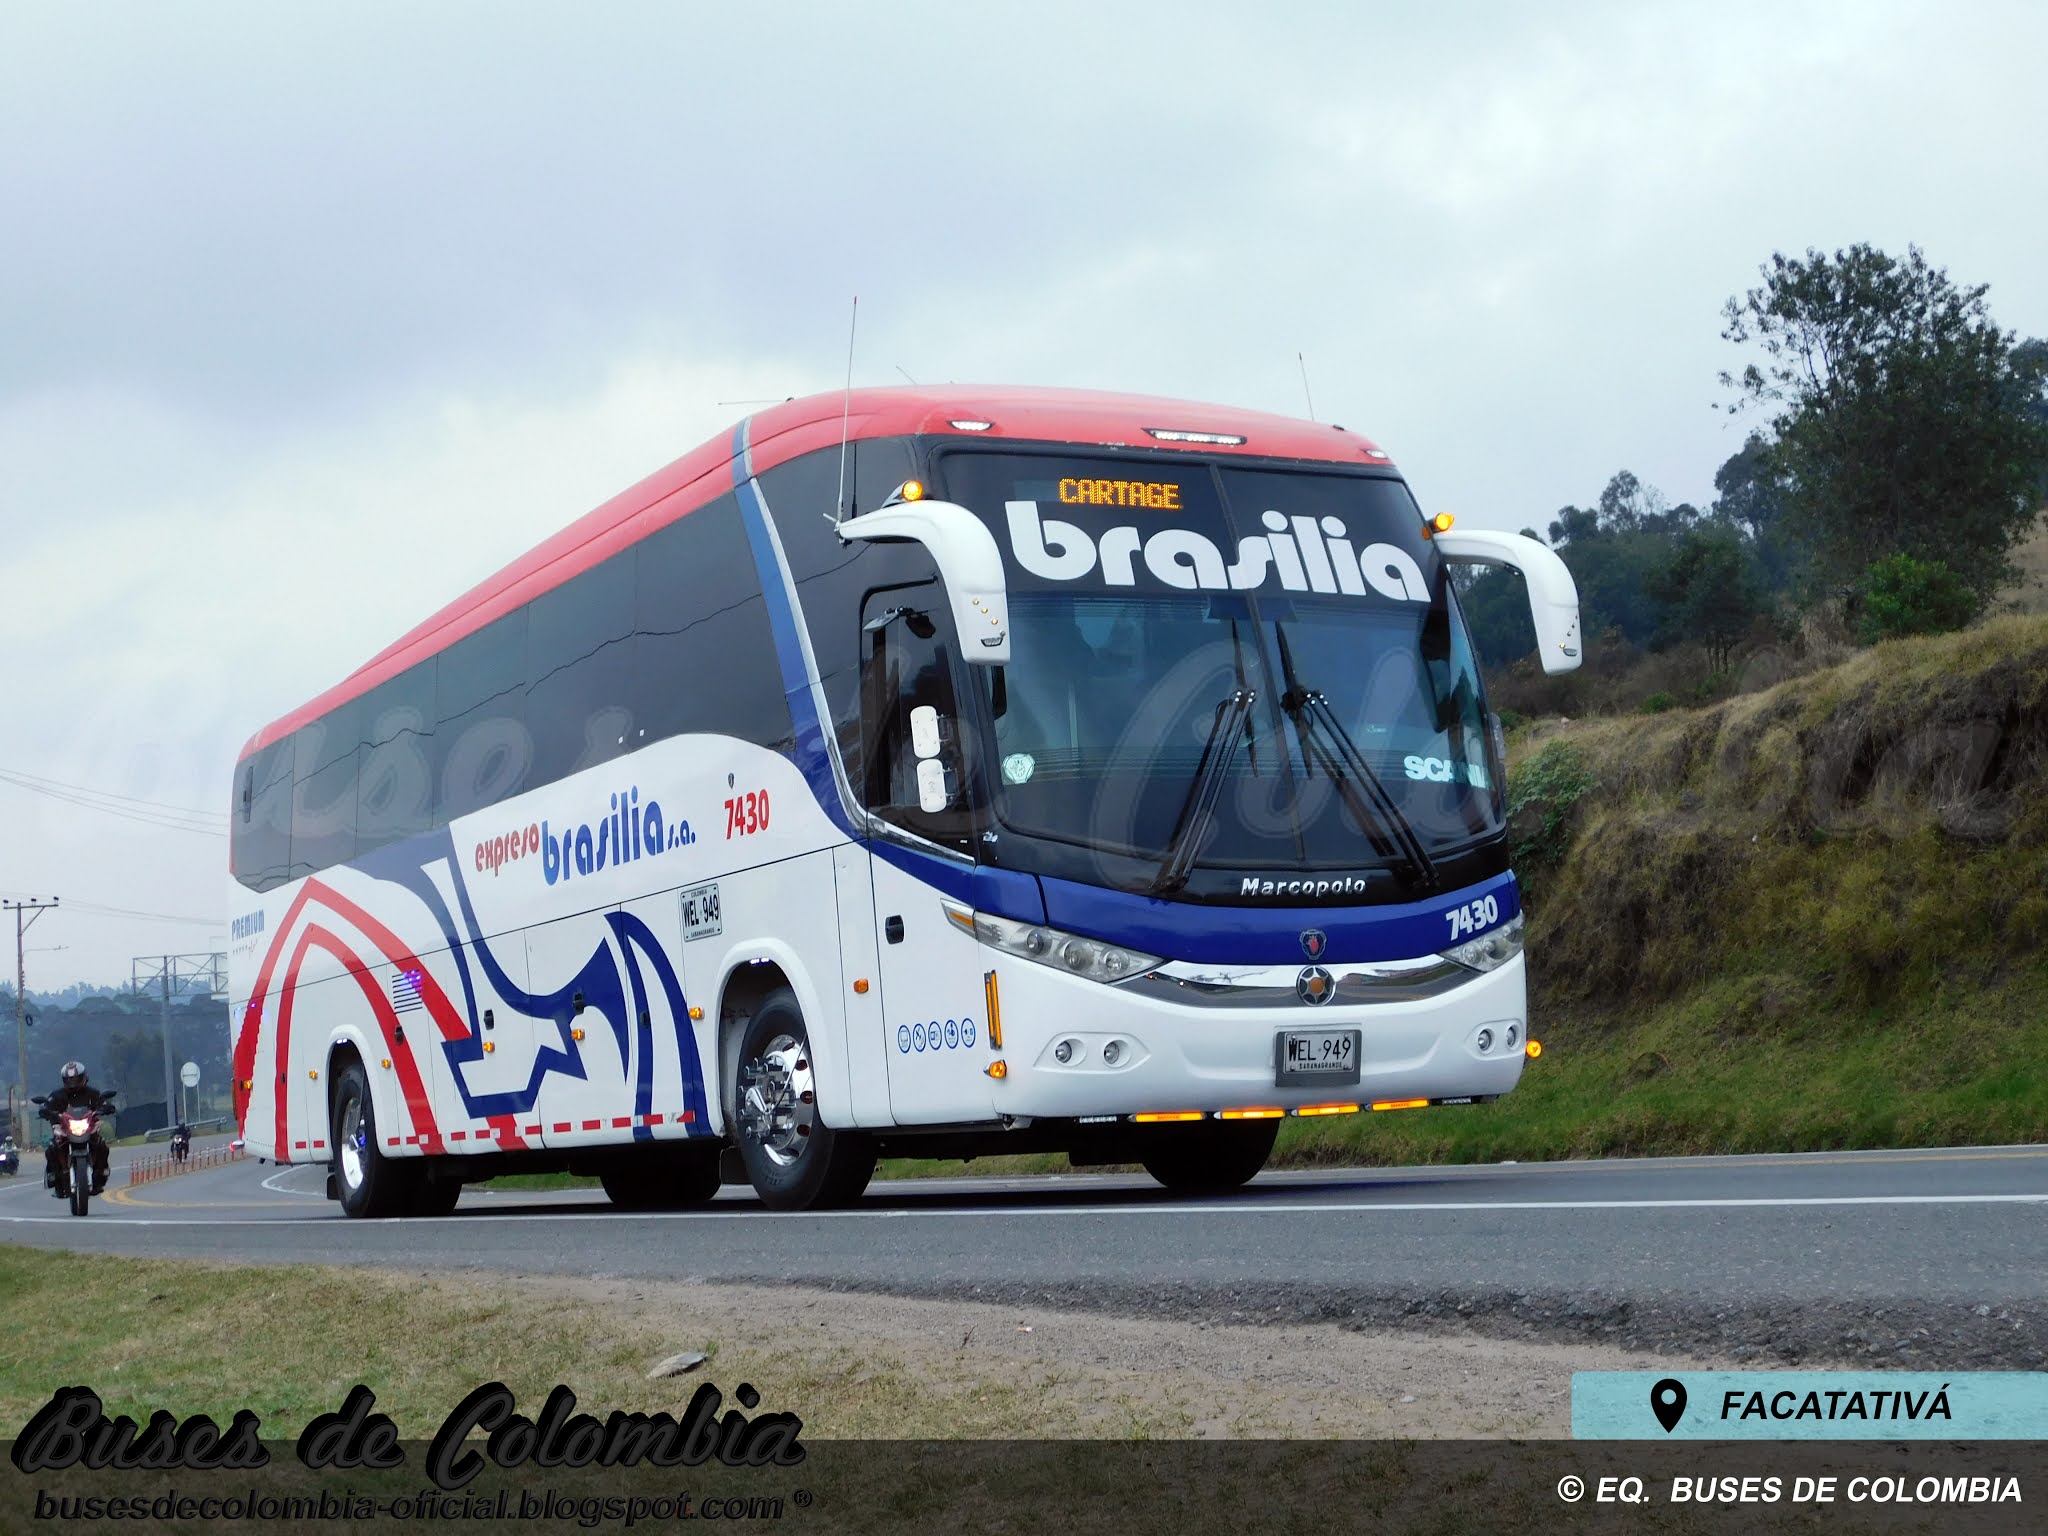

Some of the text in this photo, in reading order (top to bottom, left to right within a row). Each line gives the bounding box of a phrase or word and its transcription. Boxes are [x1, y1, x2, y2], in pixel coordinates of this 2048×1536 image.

[1059, 478, 1180, 510] CARTAGE
[1004, 500, 1432, 602] brasilia
[724, 789, 770, 840] 7430
[475, 785, 697, 886] expreso brasilia s.a.
[1241, 876, 1367, 898] Marcopolo
[231, 909, 265, 942] PREMIUM
[682, 894, 719, 928] WEL 949
[1445, 894, 1499, 941] 7430
[1288, 1039, 1351, 1062] WEL 949
